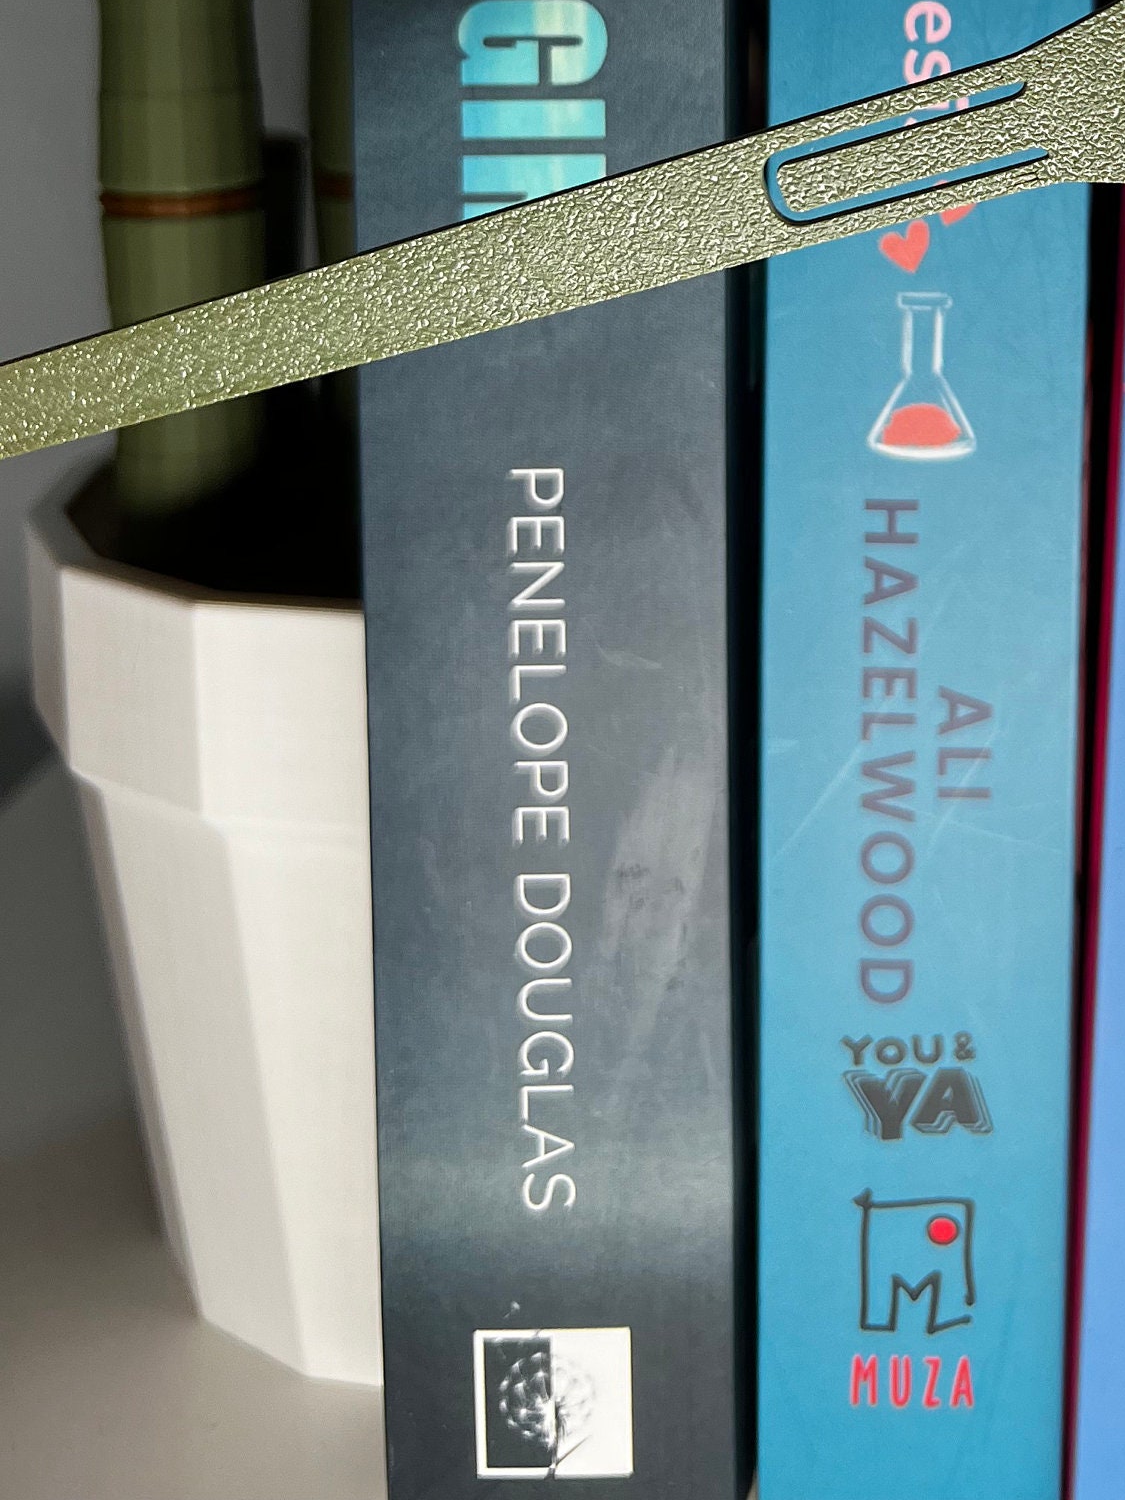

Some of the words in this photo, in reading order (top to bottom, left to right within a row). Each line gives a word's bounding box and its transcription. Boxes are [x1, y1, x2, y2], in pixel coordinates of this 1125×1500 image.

[507, 467, 571, 846] PENELOPE
[858, 498, 920, 1006] HAZELWOOD
[936, 685, 994, 801] ALI
[515, 873, 577, 1213] DOUGLAS
[840, 1033, 944, 1067] YOU
[953, 1030, 977, 1062] &
[842, 1066, 994, 1141] YA
[848, 1353, 975, 1409] MUZA
